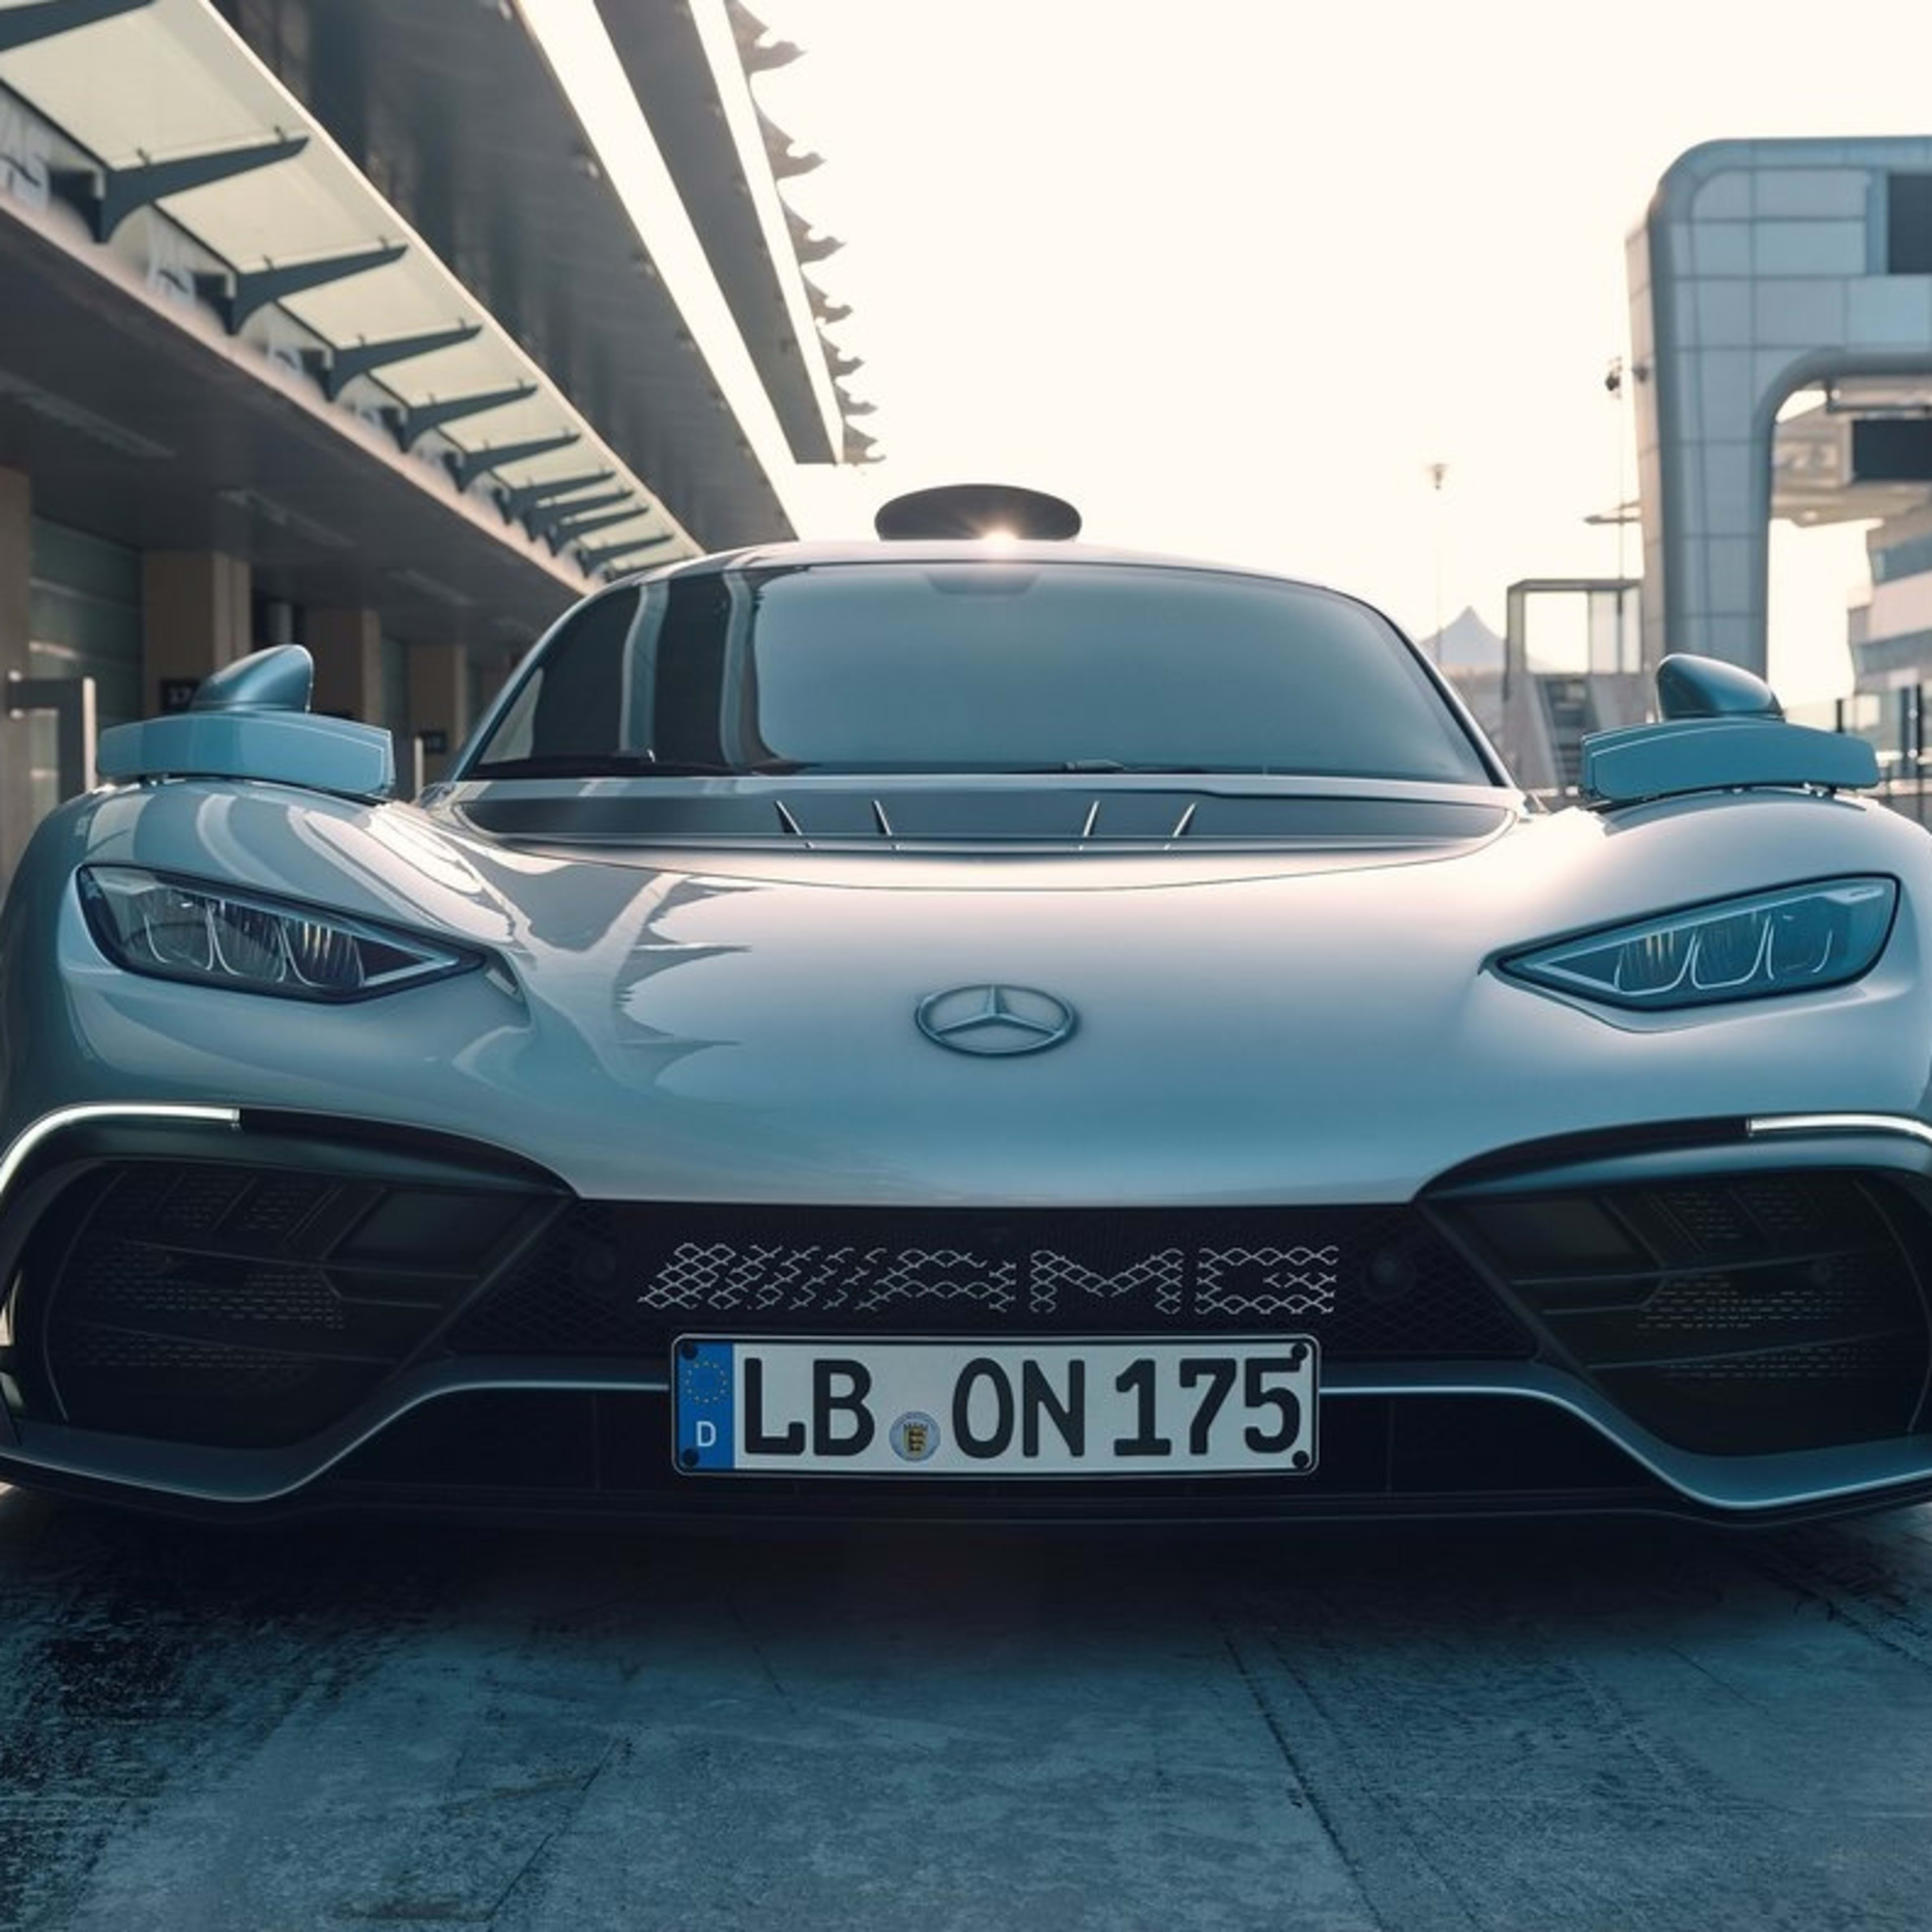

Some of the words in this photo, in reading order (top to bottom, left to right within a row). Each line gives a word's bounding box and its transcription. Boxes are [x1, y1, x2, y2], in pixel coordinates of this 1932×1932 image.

[696, 1421, 716, 1446] D
[744, 1357, 875, 1457] LB
[951, 1357, 1086, 1459] ON
[1113, 1356, 1302, 1457] 175
